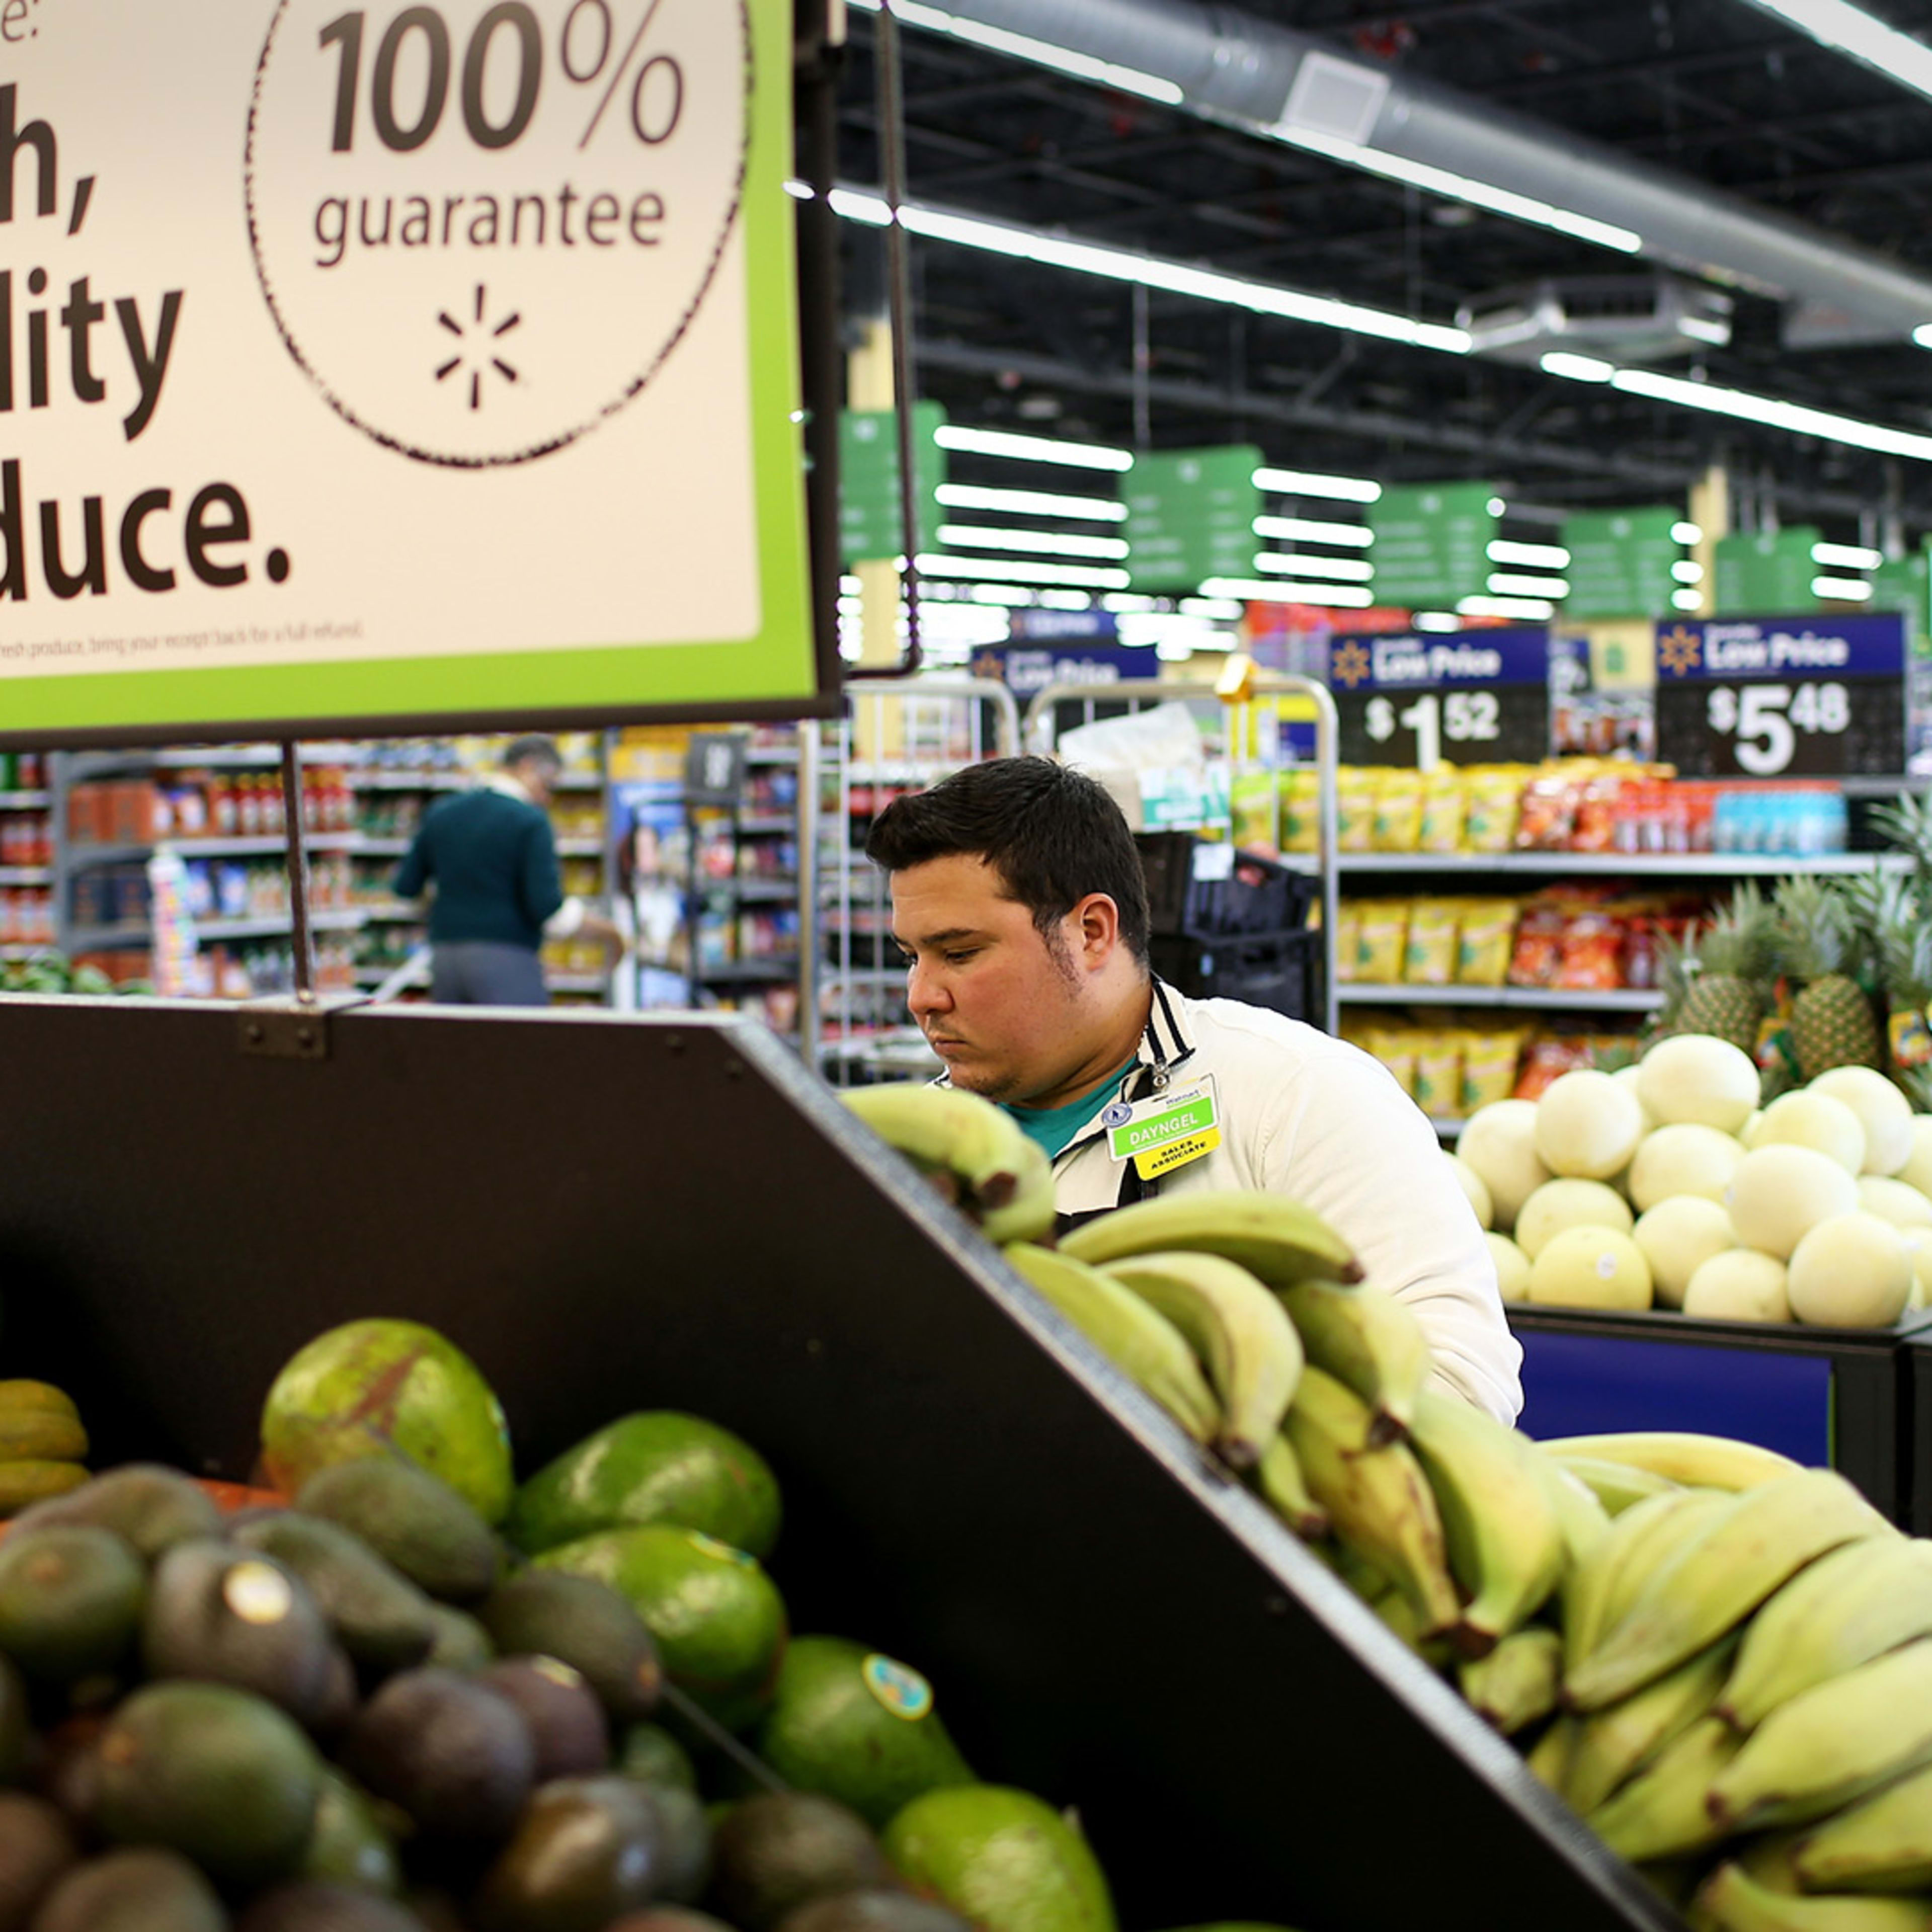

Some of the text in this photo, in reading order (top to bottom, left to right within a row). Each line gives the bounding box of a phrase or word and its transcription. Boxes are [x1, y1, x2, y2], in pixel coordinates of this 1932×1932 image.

[318, 0, 683, 154] 100%
[314, 180, 665, 268] guarantee
[1429, 643, 1502, 680] Price
[1769, 631, 1849, 669] Price
[1130, 1112, 1199, 1146] DAYNGEL
[1151, 1141, 1206, 1170] ASSOCIATE
[1161, 1141, 1193, 1157] SALES
